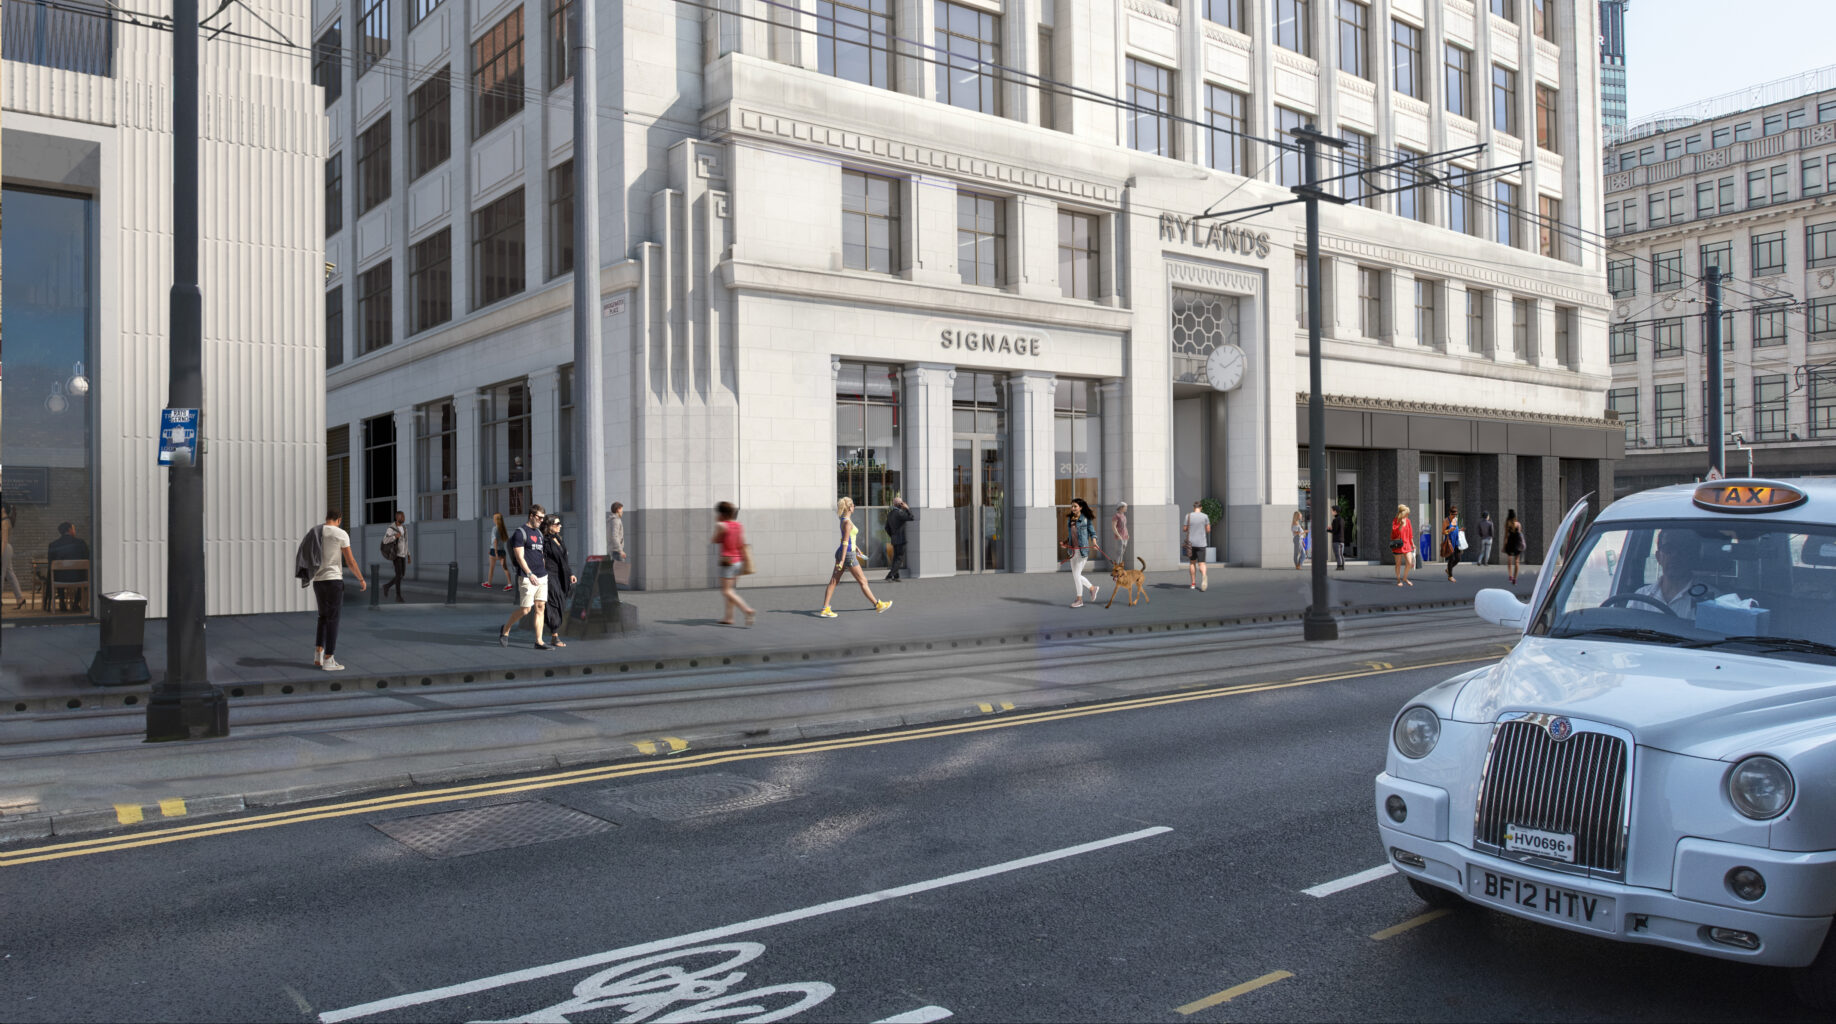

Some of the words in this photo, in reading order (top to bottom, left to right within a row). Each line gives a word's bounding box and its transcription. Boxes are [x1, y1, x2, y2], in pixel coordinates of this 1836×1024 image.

[1159, 212, 1271, 259] RYLANDS
[940, 329, 1041, 356] SIGNAGE
[1712, 487, 1775, 504] TAXI
[1514, 832, 1566, 852] HV0696
[1485, 871, 1537, 908] BF12
[1545, 887, 1598, 922] HTV
